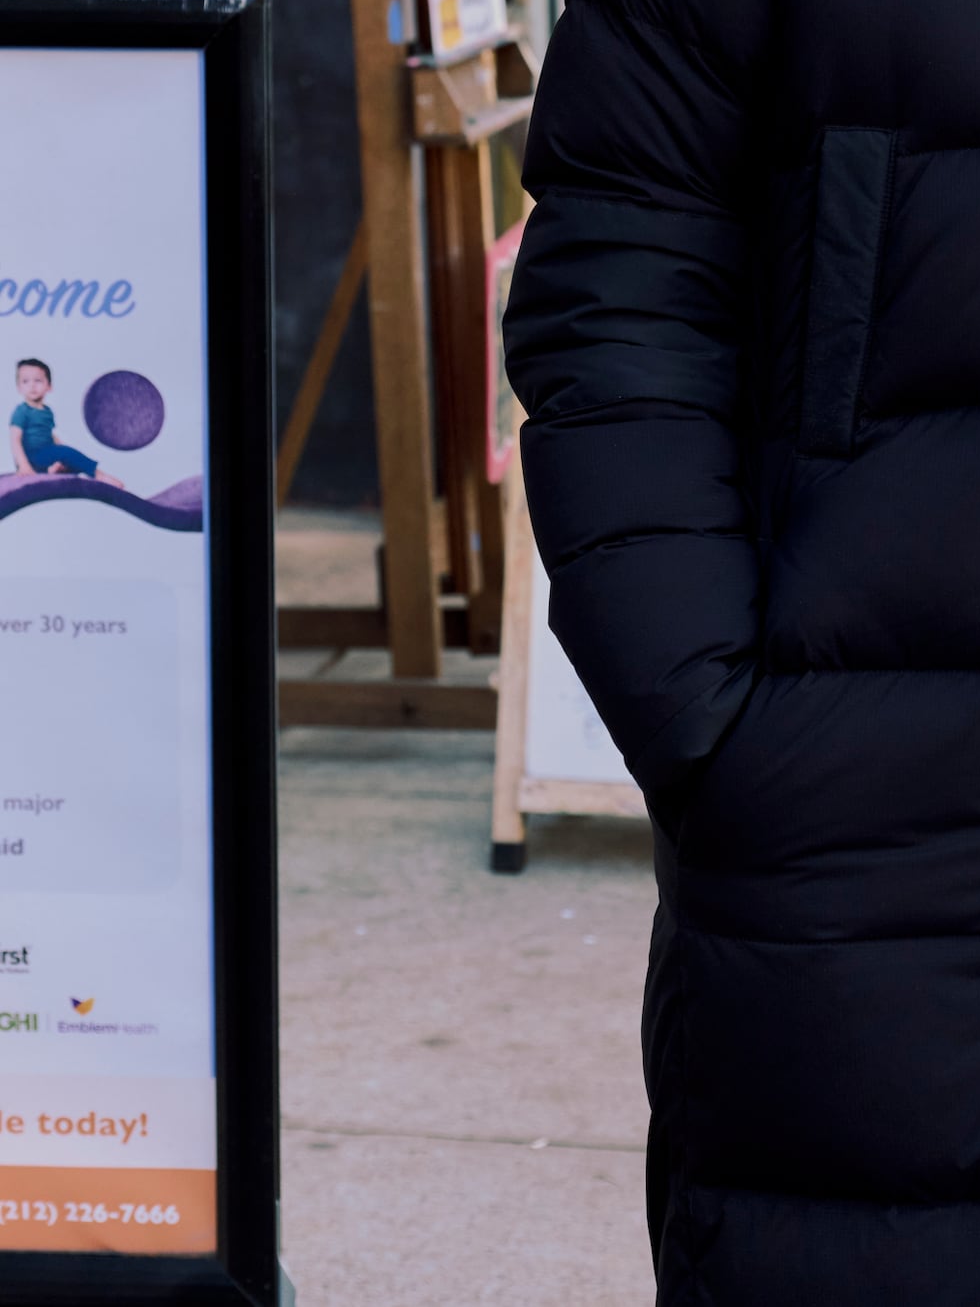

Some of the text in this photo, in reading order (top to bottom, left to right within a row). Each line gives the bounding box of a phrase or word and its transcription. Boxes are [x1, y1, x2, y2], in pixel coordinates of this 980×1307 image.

[0, 278, 136, 318] come
[40, 615, 64, 634] 30
[72, 619, 127, 638] years
[3, 795, 65, 816] major
[0, 838, 24, 855] id
[38, 1111, 149, 1144] today!
[64, 1202, 181, 1225] 226-7666
